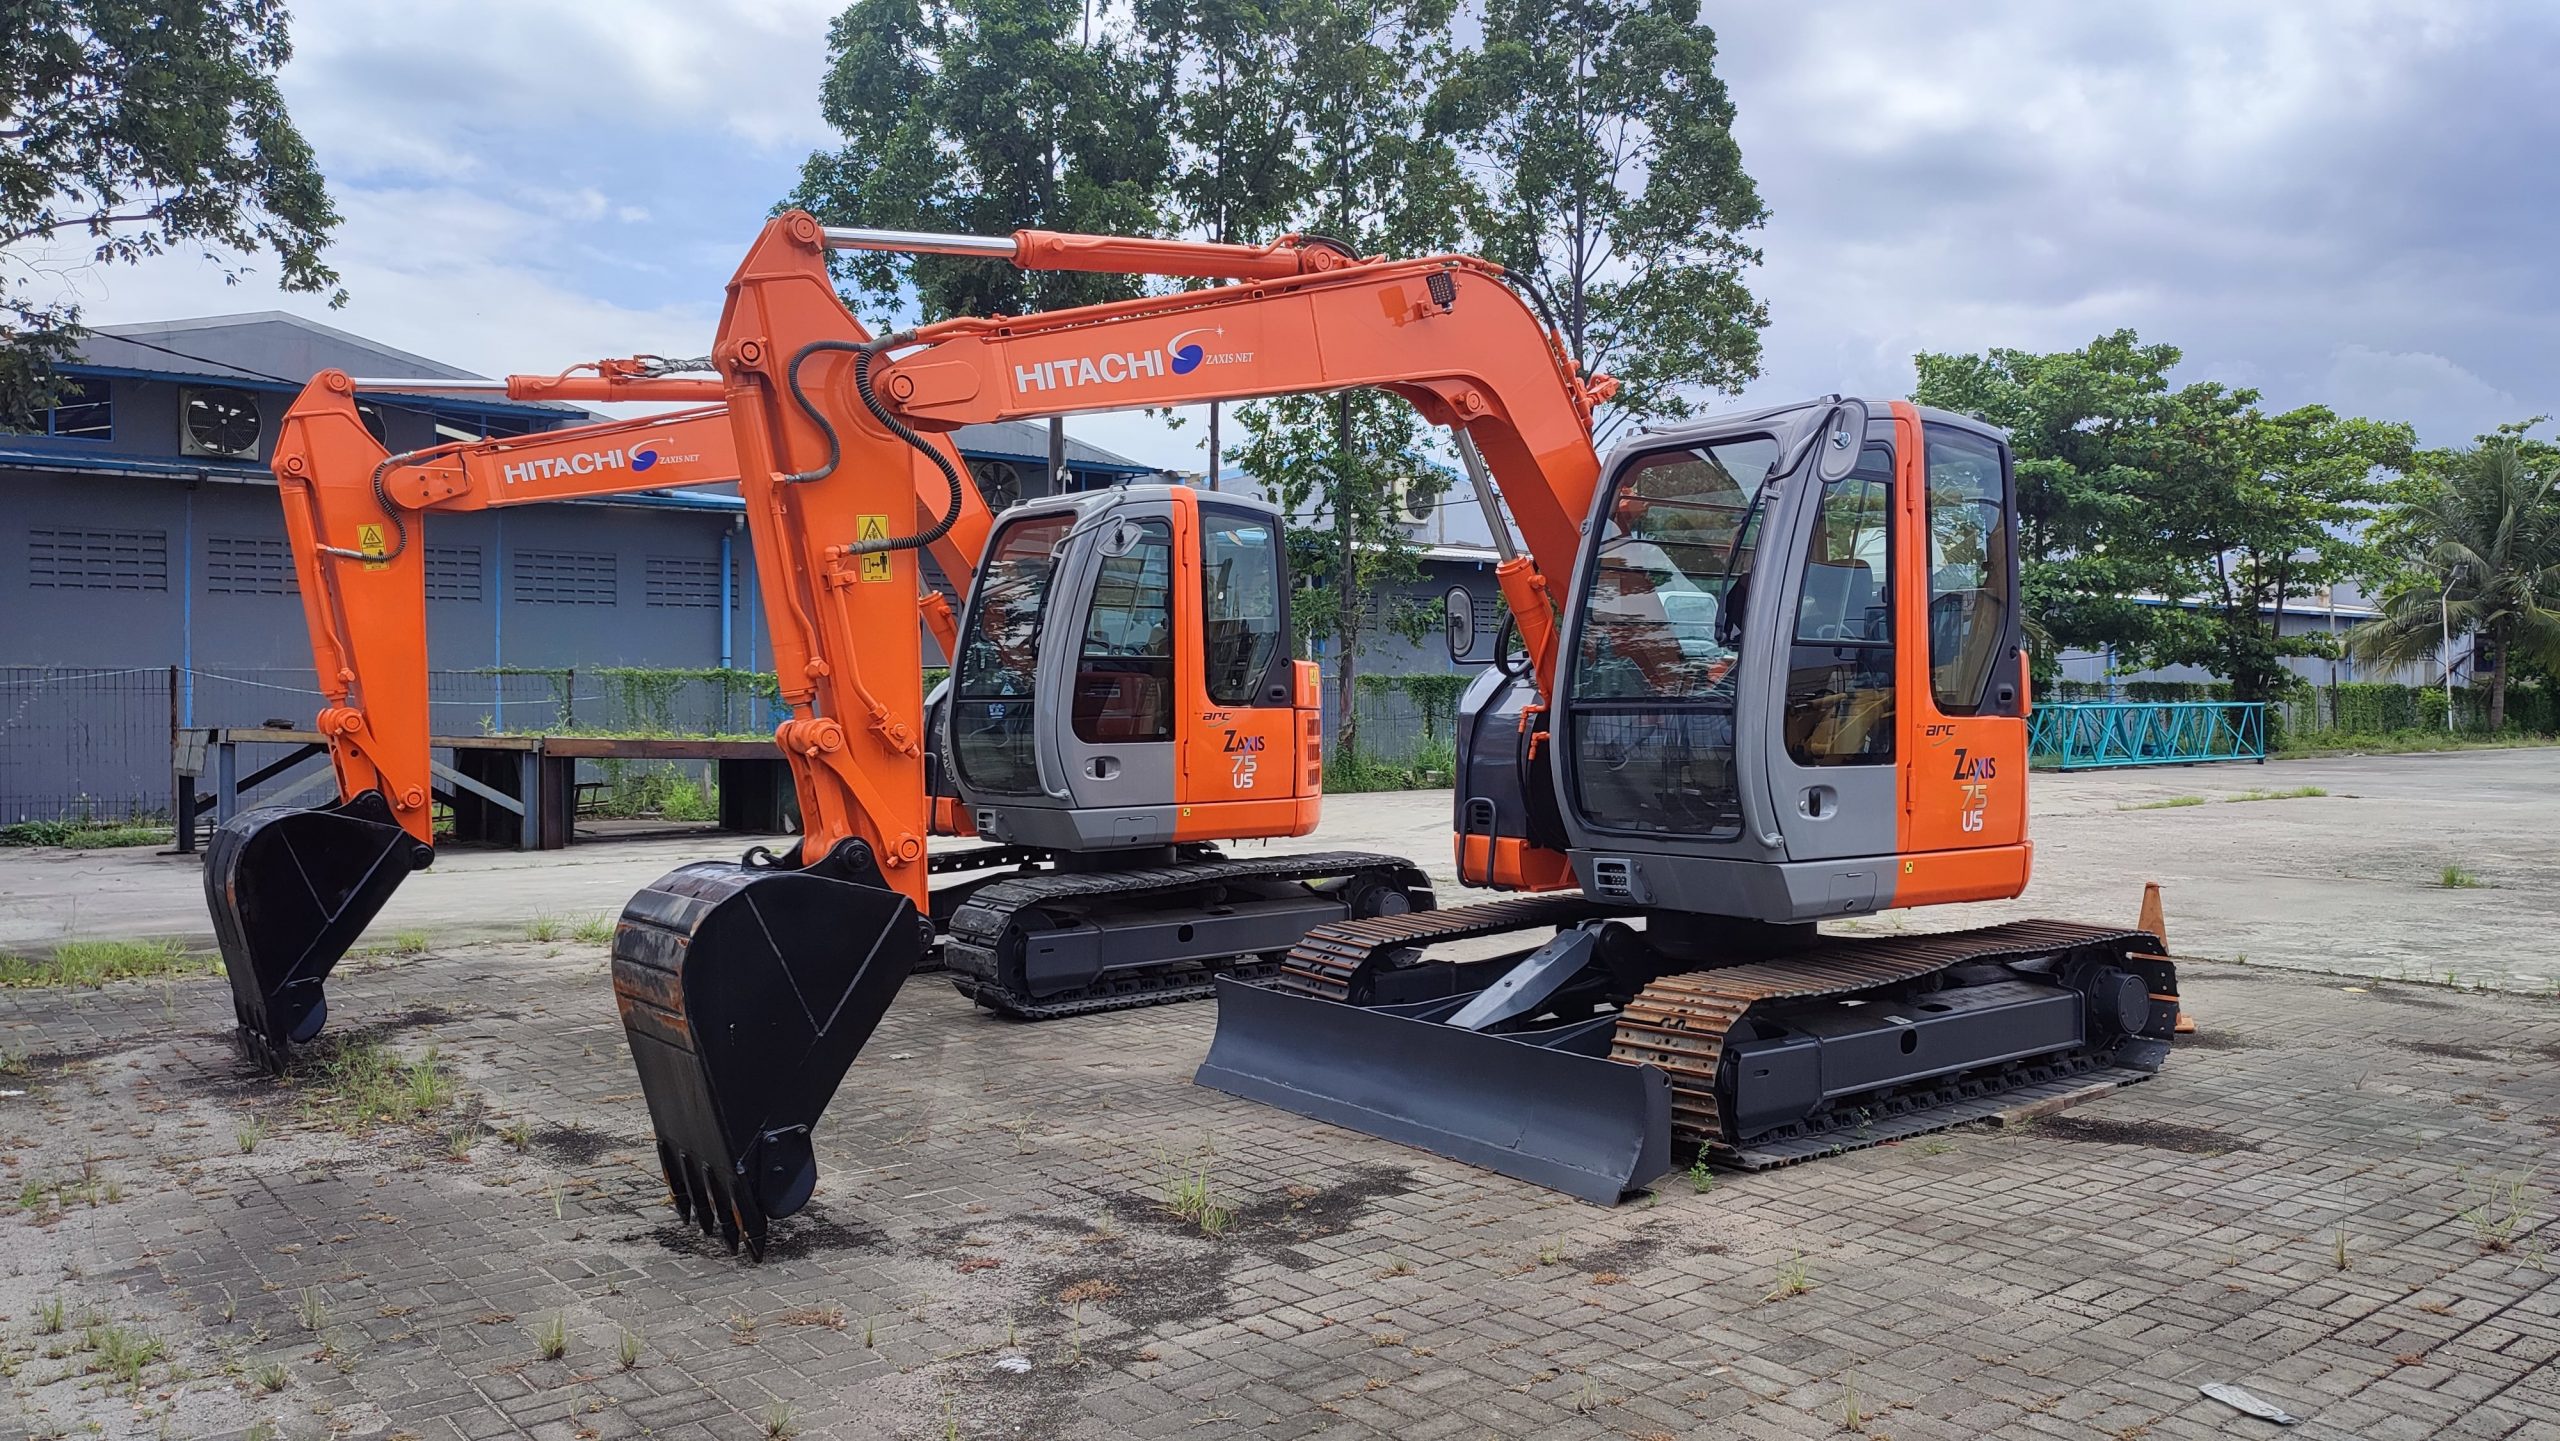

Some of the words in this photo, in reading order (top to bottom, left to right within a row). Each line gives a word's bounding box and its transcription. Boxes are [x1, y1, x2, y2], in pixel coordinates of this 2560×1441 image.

[1205, 353, 1234, 365] ZAXIS
[1235, 352, 1254, 363] NET
[1015, 349, 1165, 393] HITACHI
[503, 449, 625, 484] HITACHI
[659, 455, 683, 465] ZAXIS
[684, 454, 700, 463] NET
[1202, 712, 1232, 721] arc
[1926, 724, 1956, 736] arc
[1223, 729, 1265, 753] ZAXIS
[1231, 754, 1257, 773] 75
[1953, 748, 1996, 781] ZAXIS
[1233, 773, 1254, 789] US
[1961, 784, 1988, 810] 75
[1962, 810, 1984, 832] US
